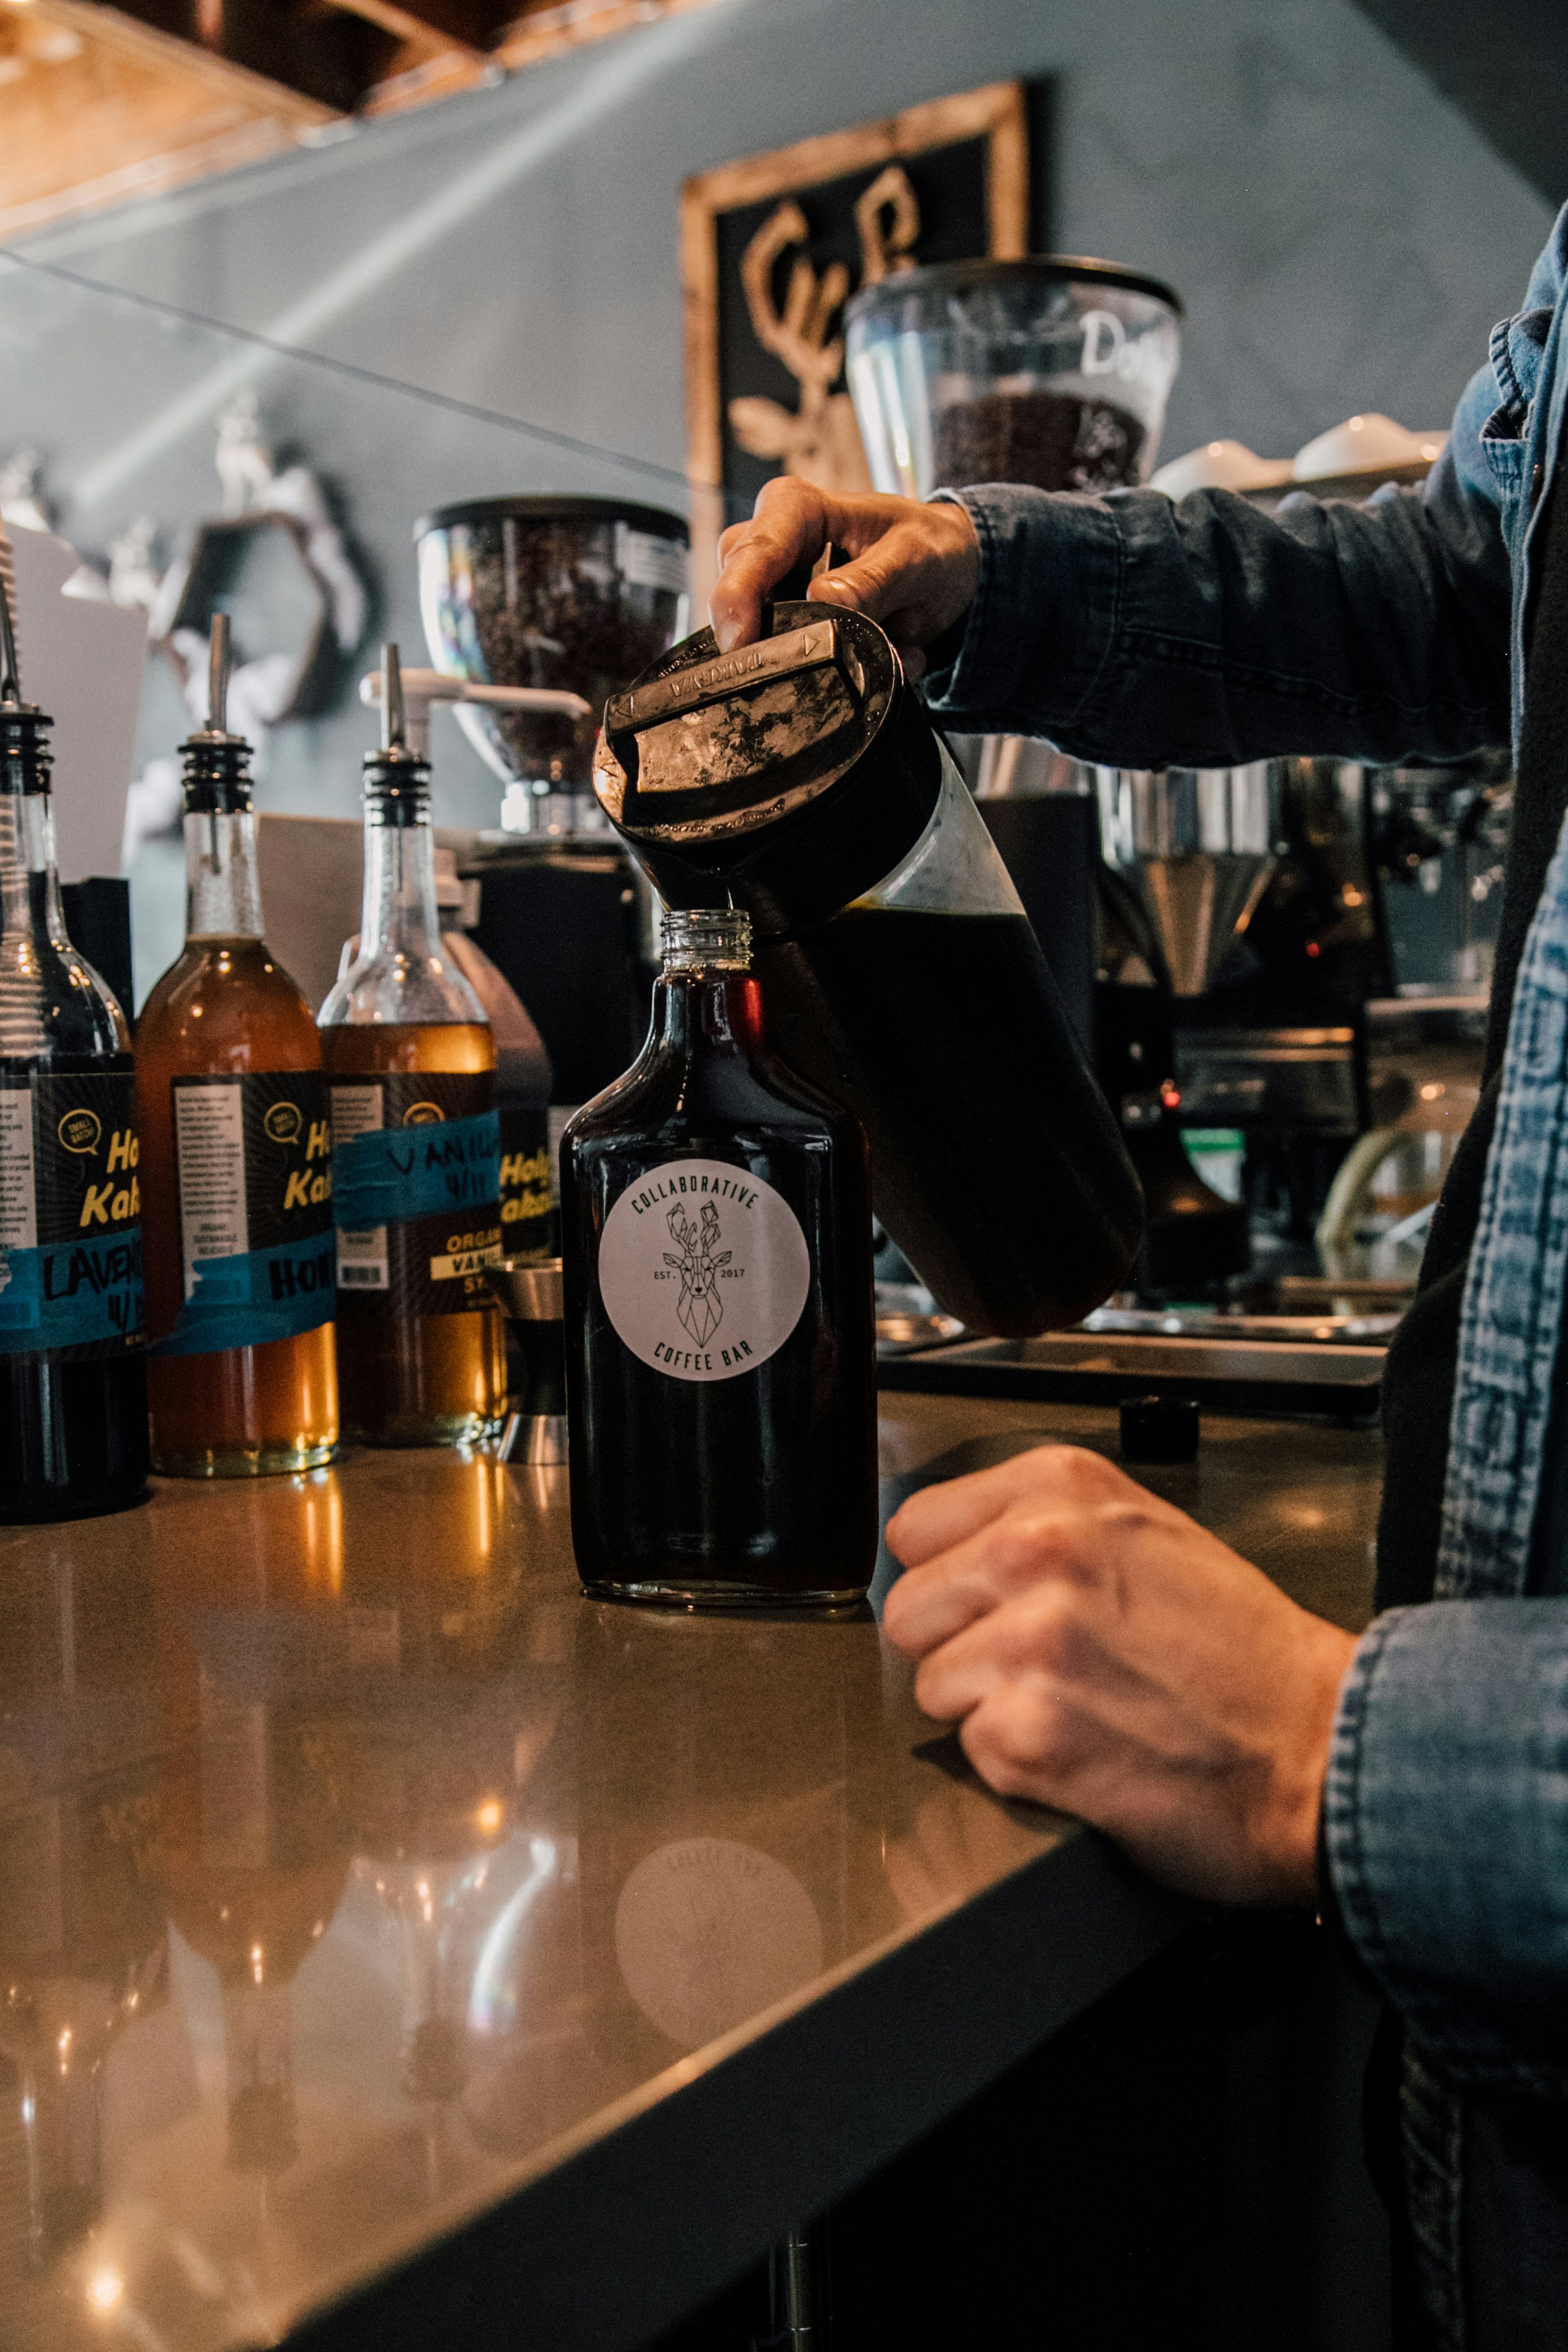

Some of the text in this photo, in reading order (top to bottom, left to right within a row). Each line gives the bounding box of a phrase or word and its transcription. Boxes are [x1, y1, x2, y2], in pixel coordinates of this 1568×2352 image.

[670, 650, 766, 698] TAKEYA
[631, 1175, 759, 1214] COLLABORATIVE
[654, 1268, 746, 1280] EST. 2017
[653, 1339, 754, 1371] COFFEE BAR
